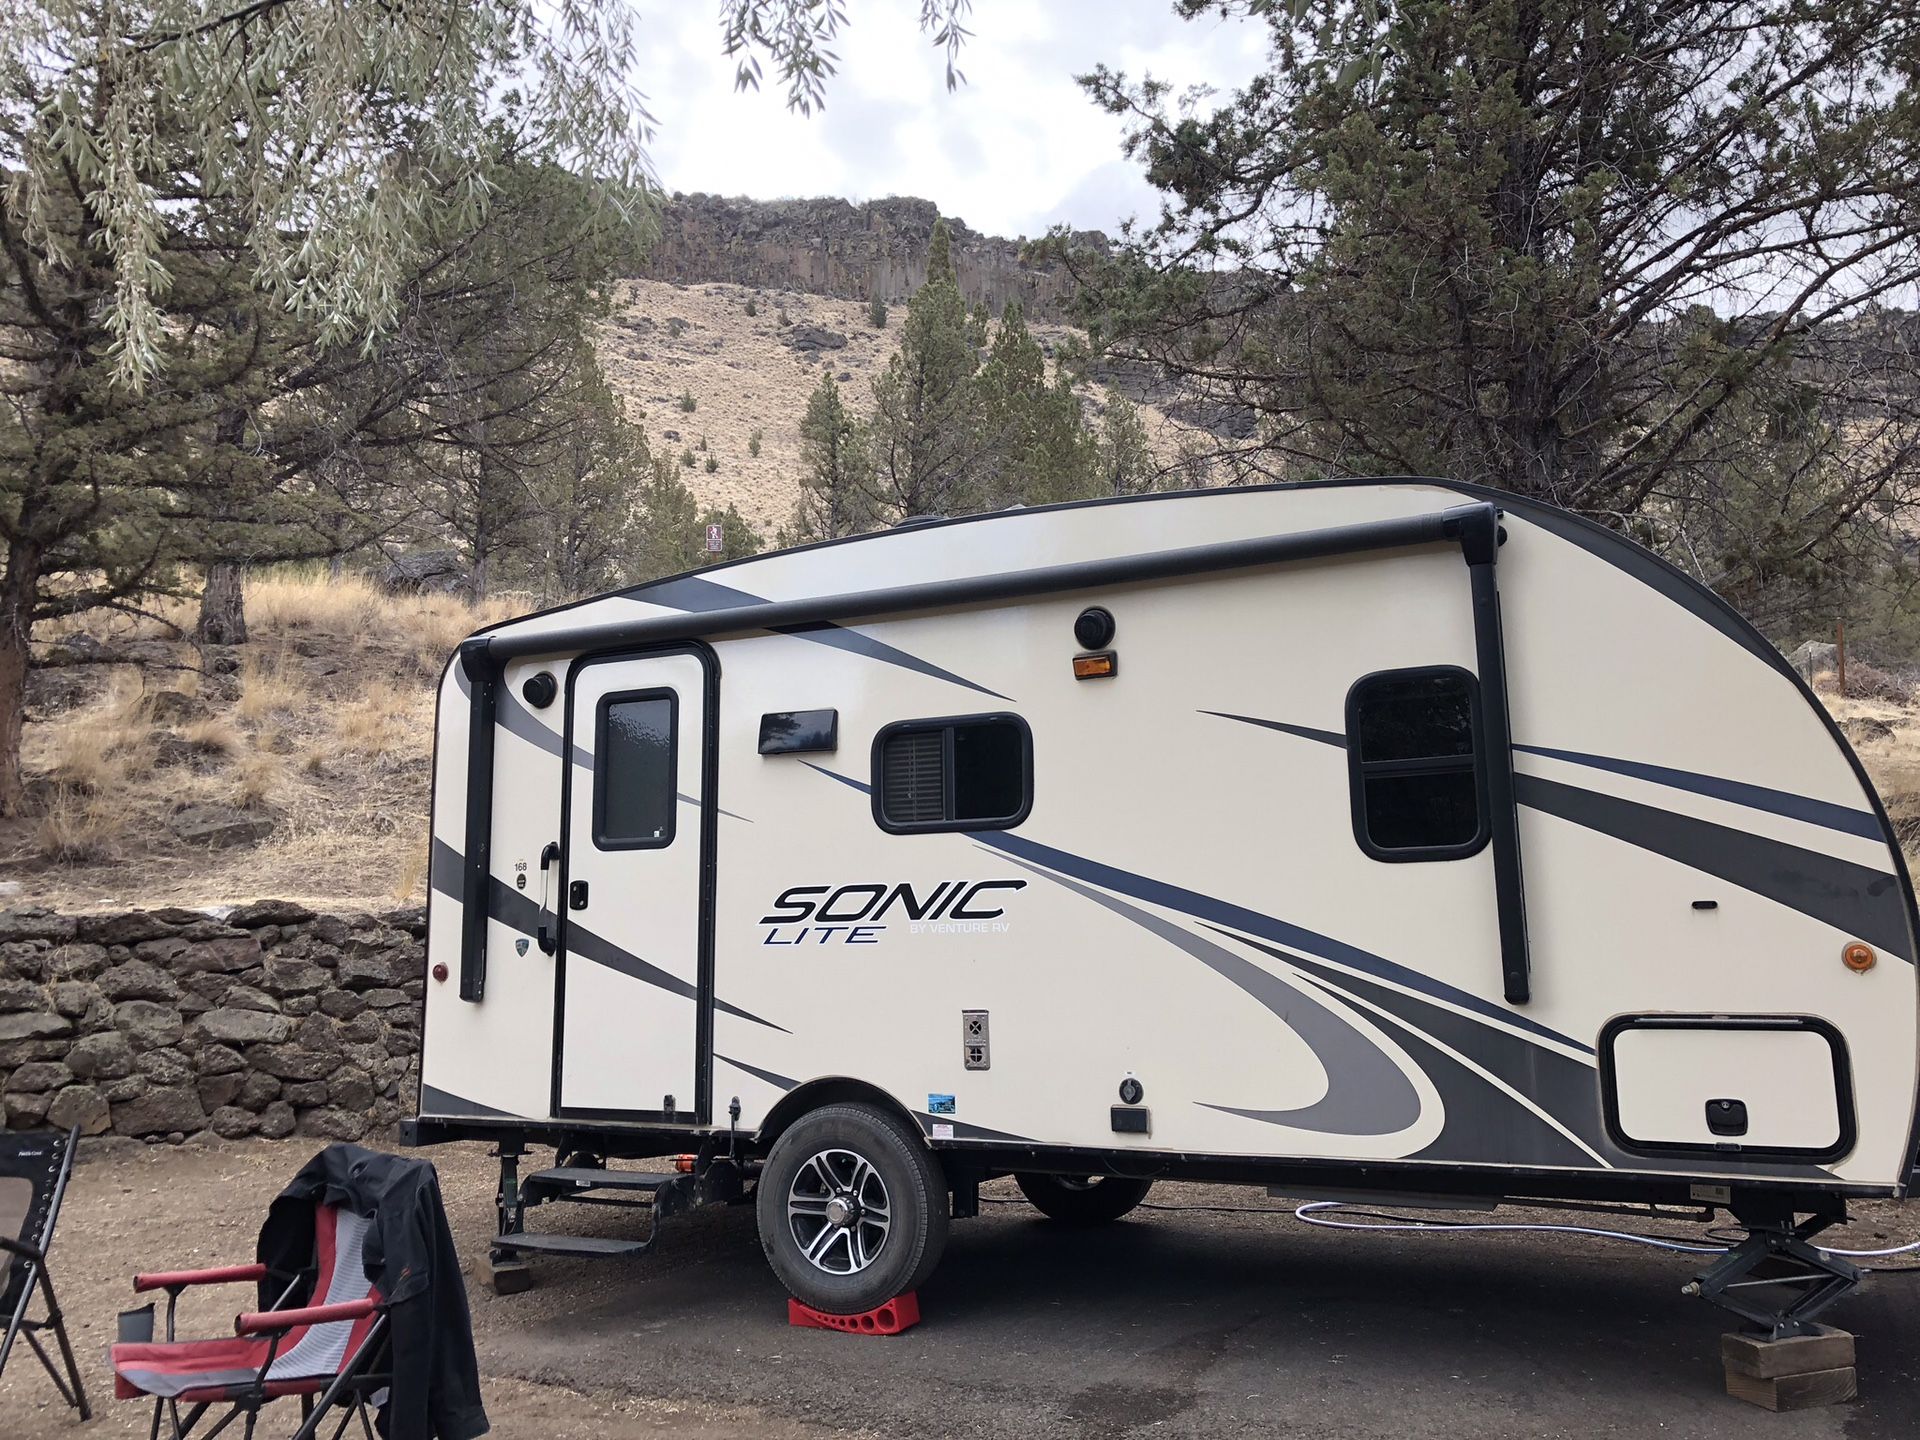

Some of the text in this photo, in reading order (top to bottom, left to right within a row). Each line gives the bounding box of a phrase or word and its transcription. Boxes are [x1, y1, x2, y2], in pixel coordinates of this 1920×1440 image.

[514, 862, 527, 871] 168
[758, 879, 1028, 924] SONIC
[762, 926, 887, 945] LITE
[910, 922, 1010, 934] BY VENTURE RV
